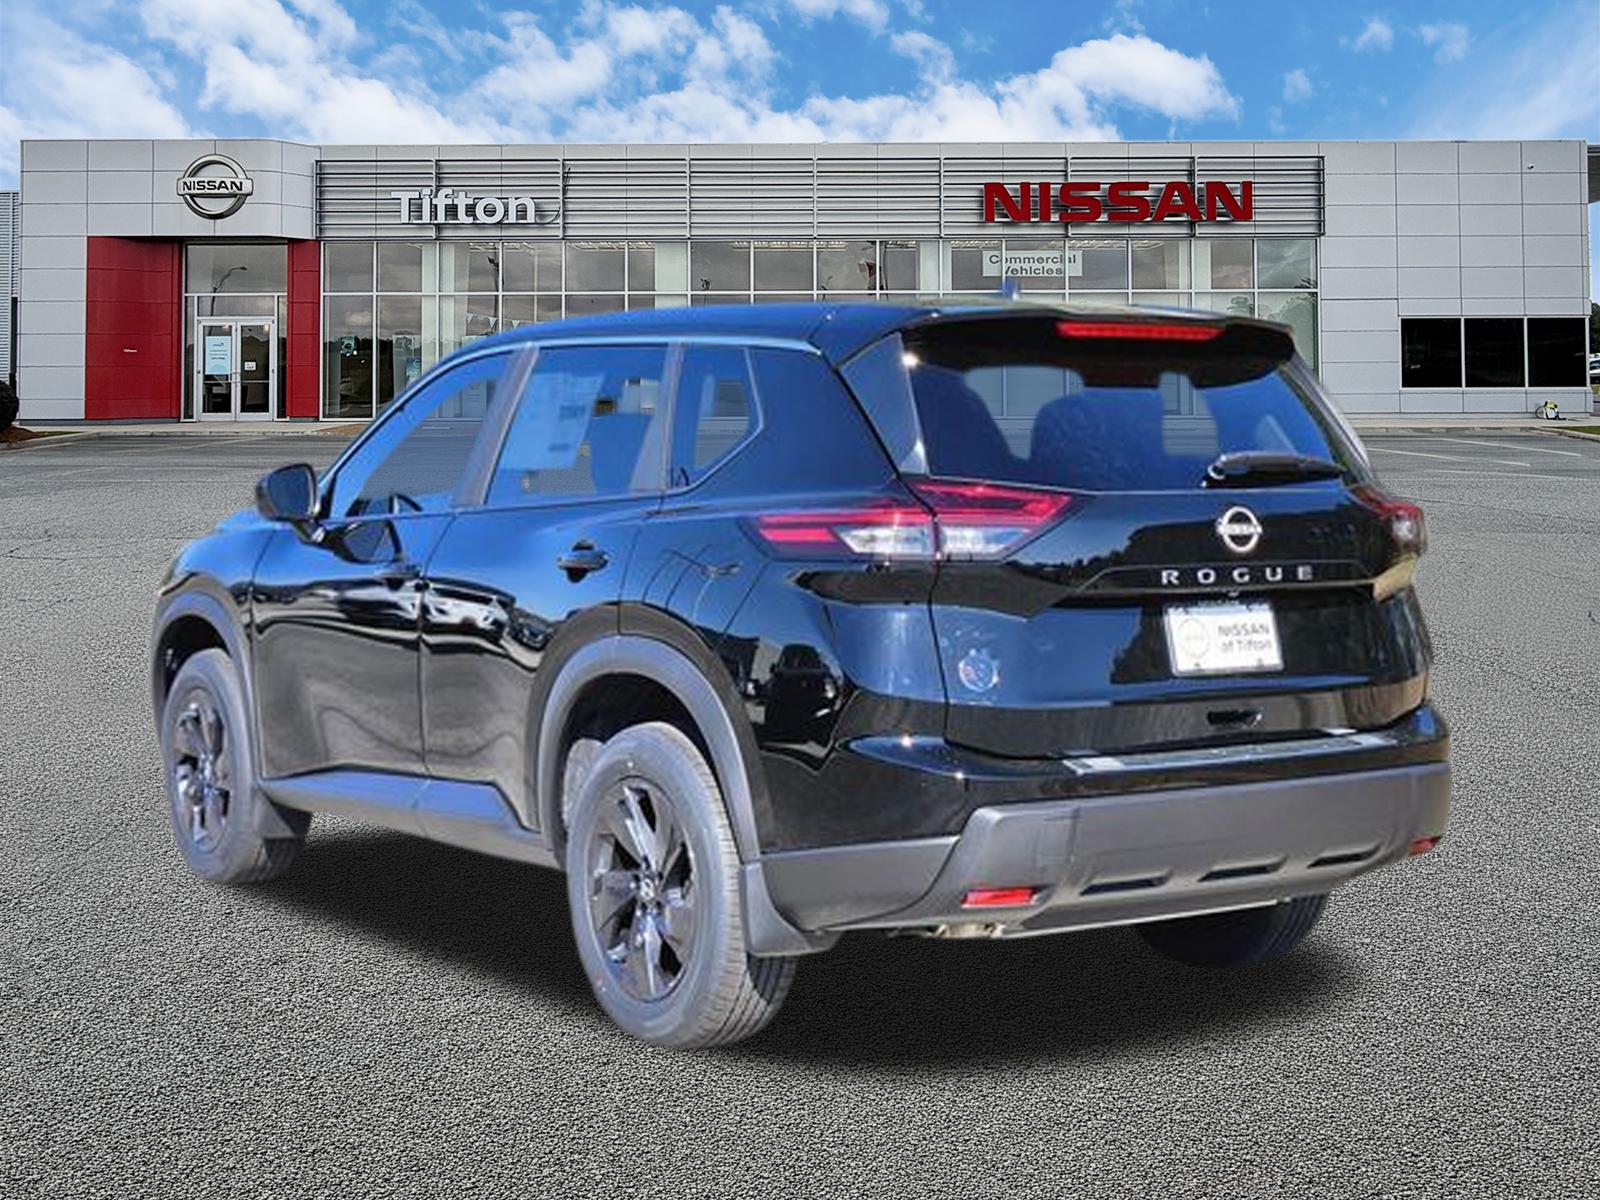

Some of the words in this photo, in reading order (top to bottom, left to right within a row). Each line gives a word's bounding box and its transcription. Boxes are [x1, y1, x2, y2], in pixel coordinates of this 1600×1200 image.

[182, 180, 243, 191] NISSAN
[391, 187, 536, 224] Tifton
[983, 181, 1254, 222] NISSAN
[1160, 565, 1314, 586] ROGUE
[1217, 623, 1270, 637] NISSAN
